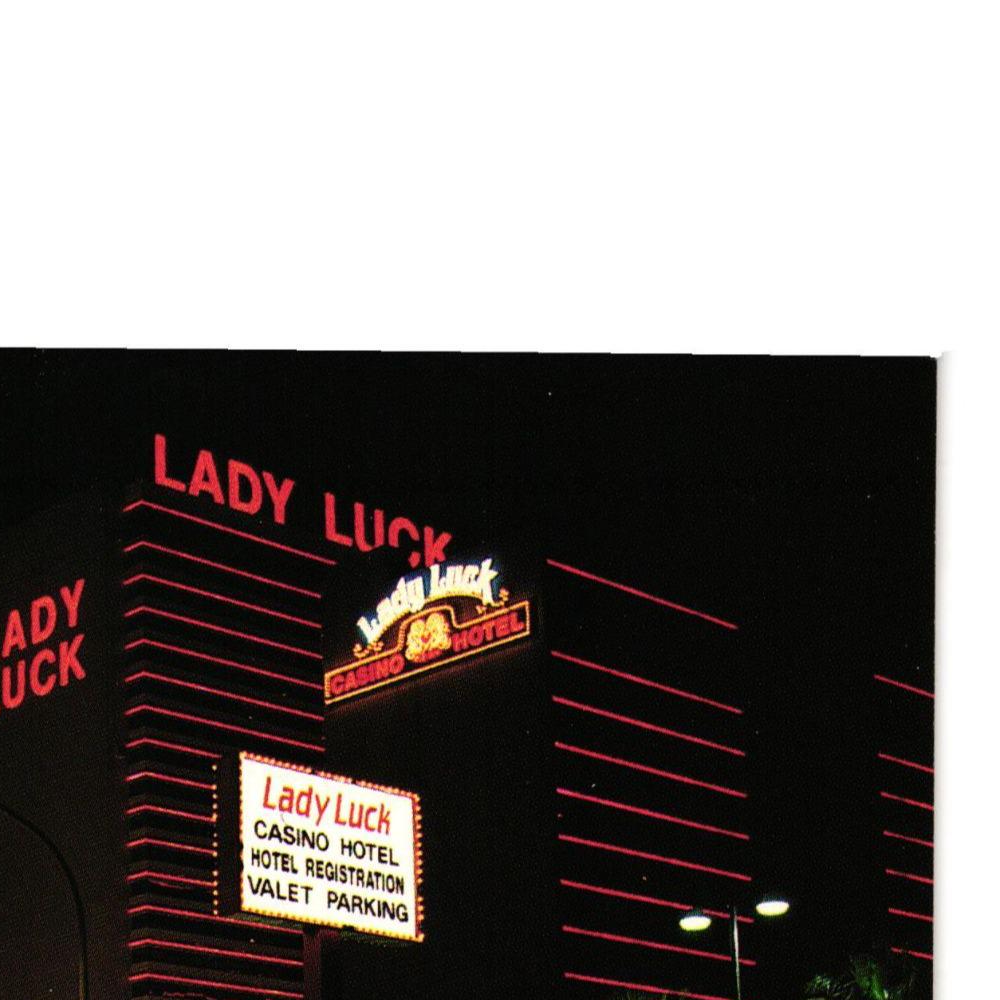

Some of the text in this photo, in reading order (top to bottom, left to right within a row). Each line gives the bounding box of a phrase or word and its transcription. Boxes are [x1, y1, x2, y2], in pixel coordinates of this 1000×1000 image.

[154, 434, 453, 568] LADY LUCK
[357, 558, 499, 645] Lady Luck
[330, 613, 525, 695] CASINO HOTEL
[263, 776, 391, 836] Lady Luck
[251, 848, 405, 896] HOTEL REGISTRATION
[254, 820, 400, 867] CASINO HOTEL
[247, 875, 409, 923] VALET PARKING
